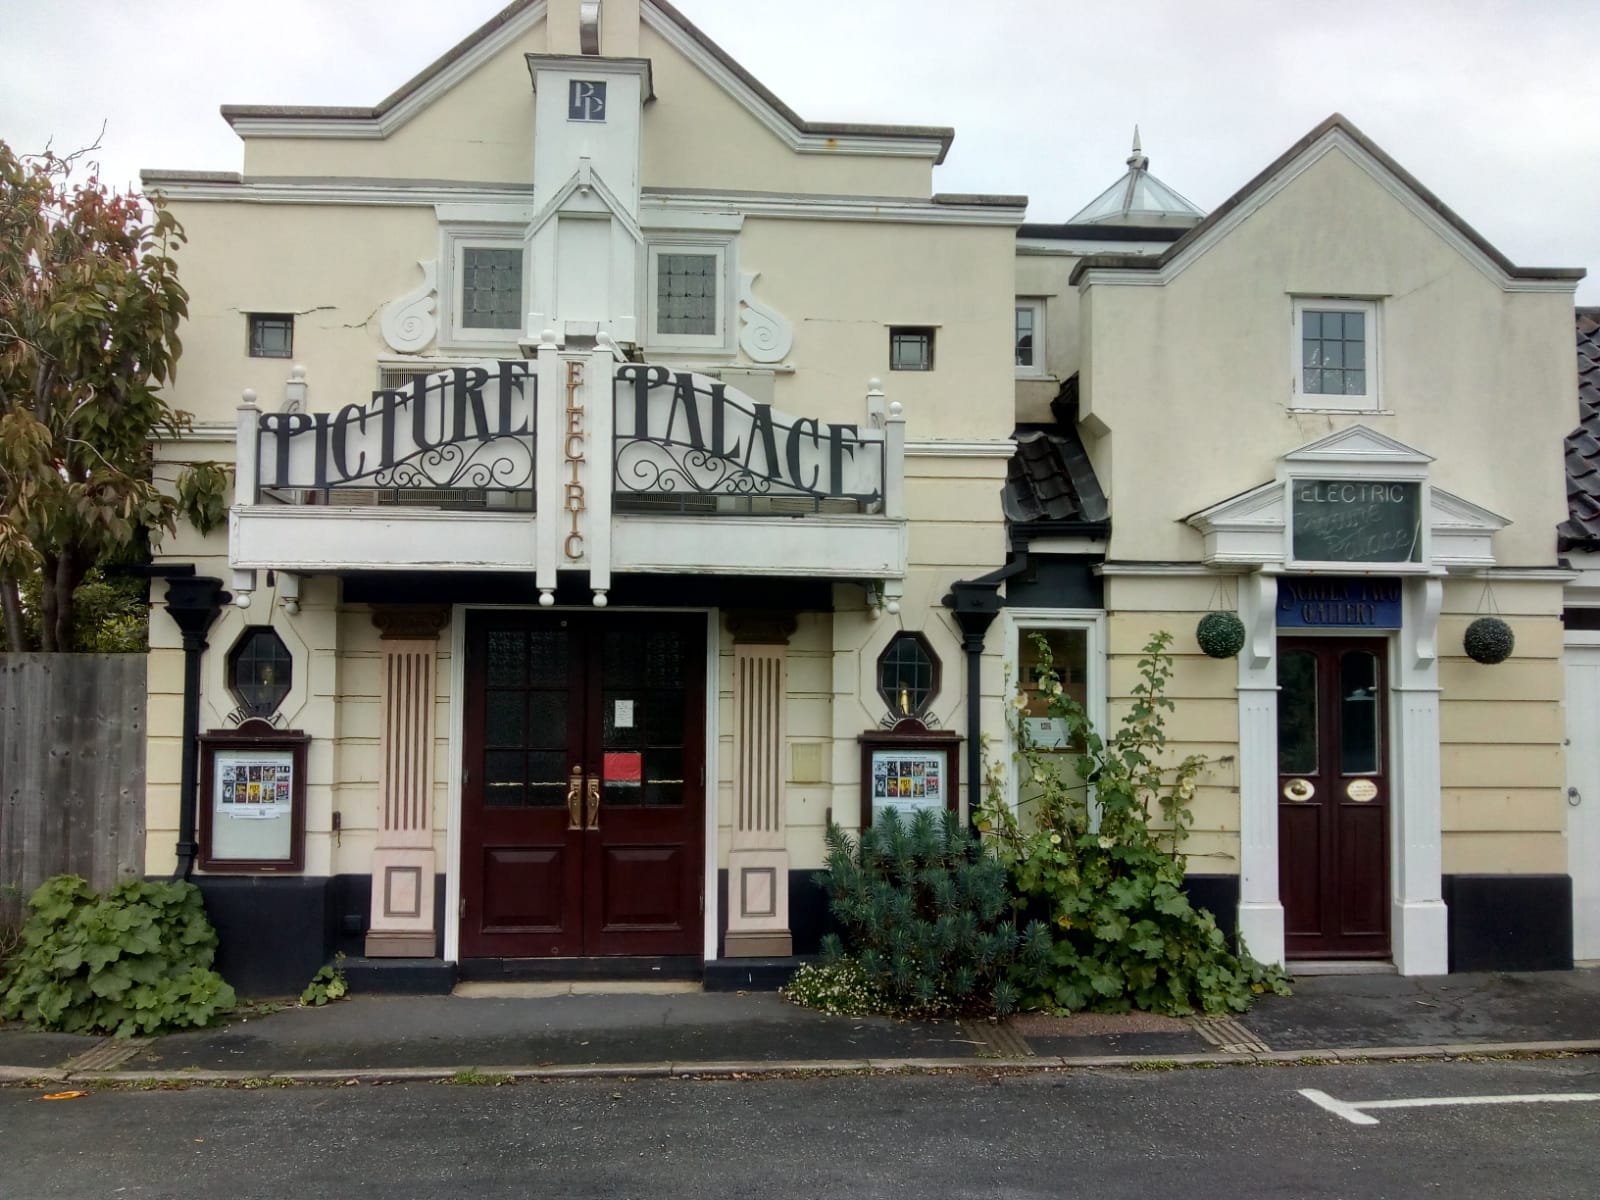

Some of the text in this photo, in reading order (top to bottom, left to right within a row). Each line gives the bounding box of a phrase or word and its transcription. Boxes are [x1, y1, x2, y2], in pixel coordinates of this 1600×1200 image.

[258, 360, 879, 503] PICTURE PALACE
[564, 361, 586, 559] ELECTRIC
[1301, 485, 1404, 503] ELECTRIC
